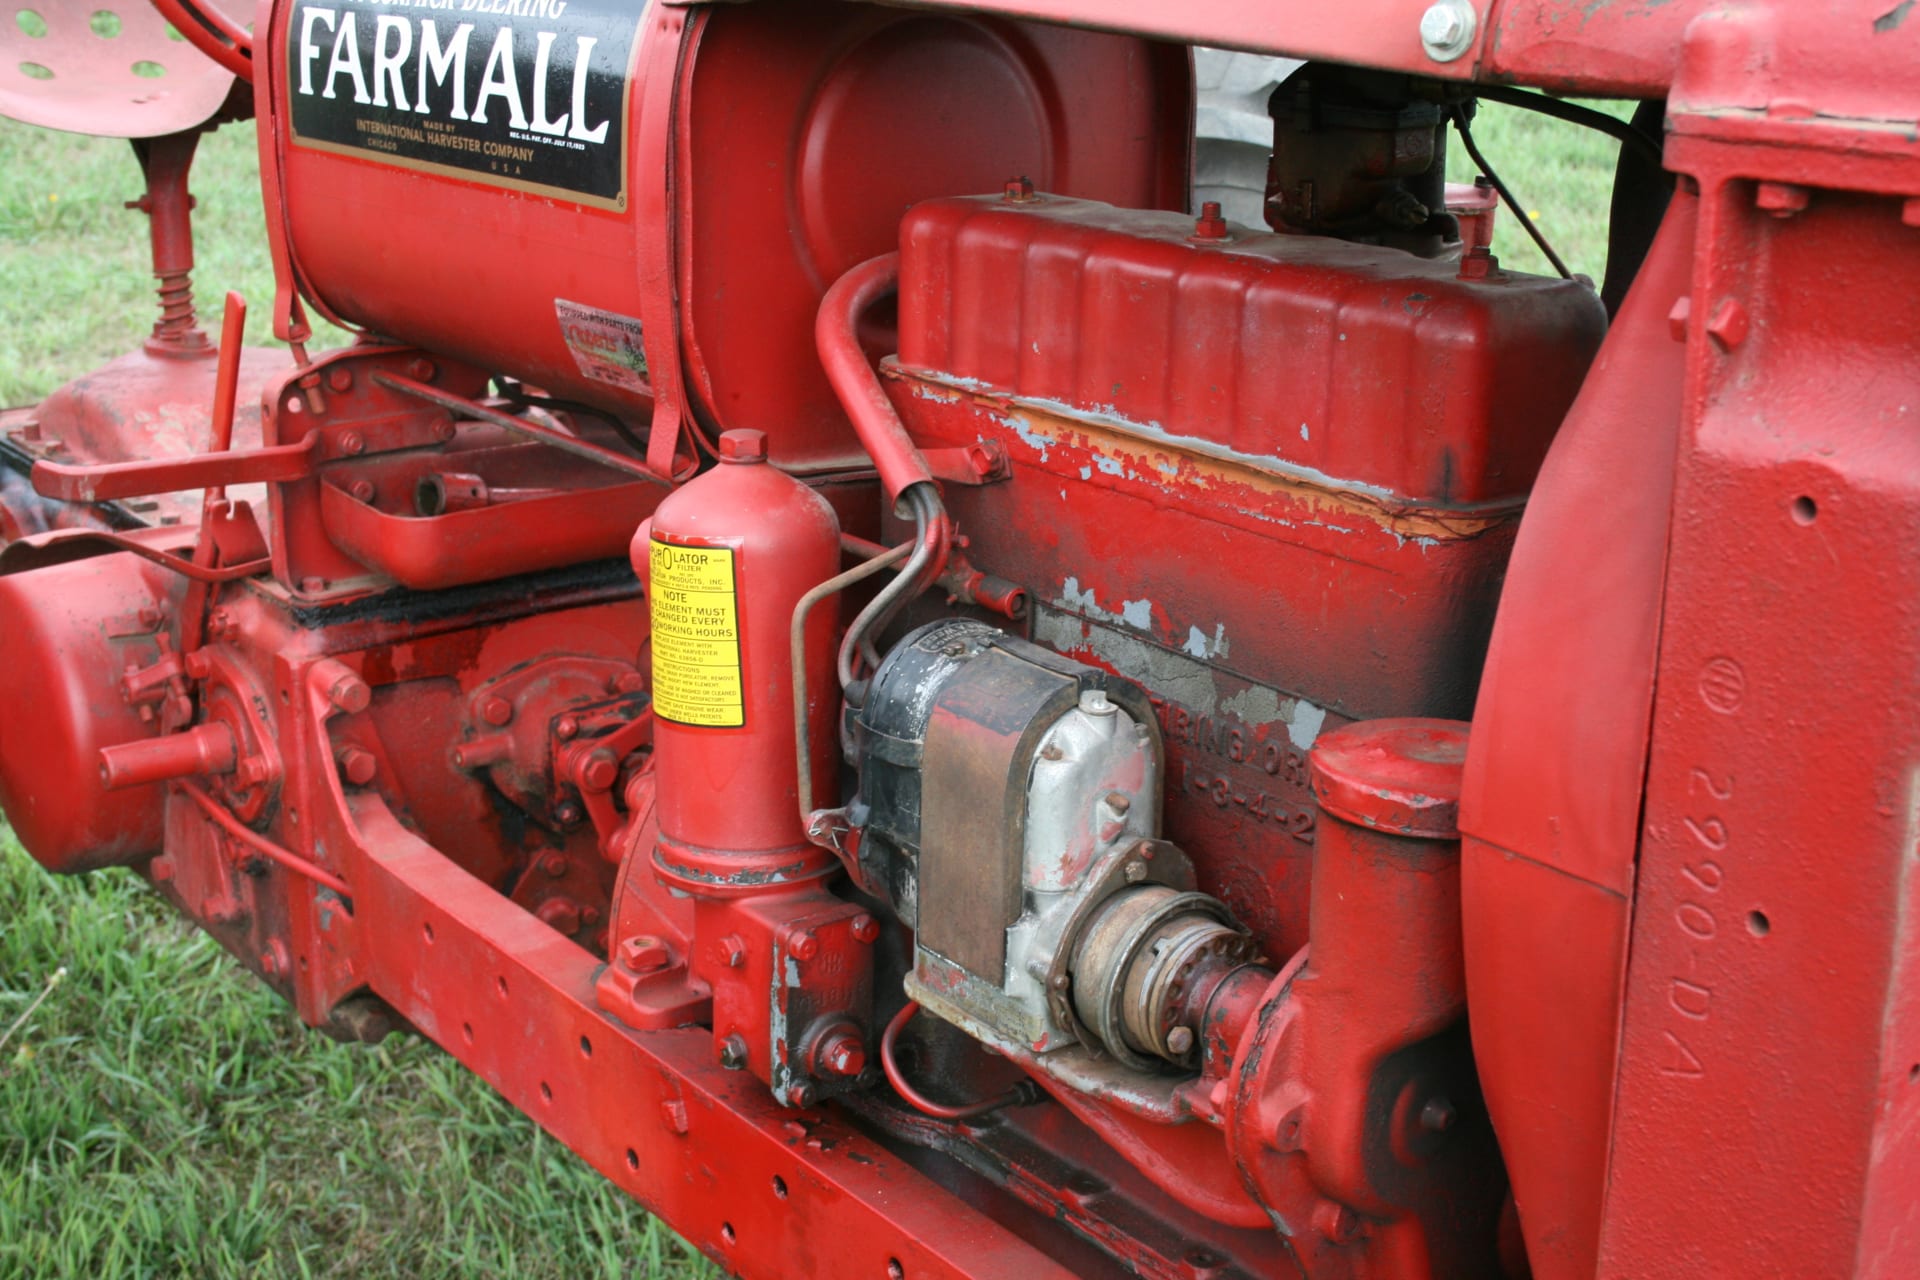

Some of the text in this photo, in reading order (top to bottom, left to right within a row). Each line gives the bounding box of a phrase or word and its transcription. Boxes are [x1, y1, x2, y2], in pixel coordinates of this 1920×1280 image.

[298, 7, 610, 145] FARMALL
[423, 120, 456, 133] MADE BY
[356, 119, 534, 162] INTERNATIONAL HARVESTER COMPANY
[367, 138, 397, 151] CHICAGO
[677, 564, 701, 572] FILTER
[664, 589, 687, 603] NOTE
[659, 601, 692, 614] ELEMENT
[695, 608, 726, 616] MUST
[656, 608, 688, 623] CHANGED
[691, 617, 725, 625] EVERY
[695, 628, 733, 637] HOURS
[671, 639, 694, 648] ELEMENT
[682, 648, 718, 656] HARVESTER
[1181, 757, 1316, 846] 1-3-4-2
